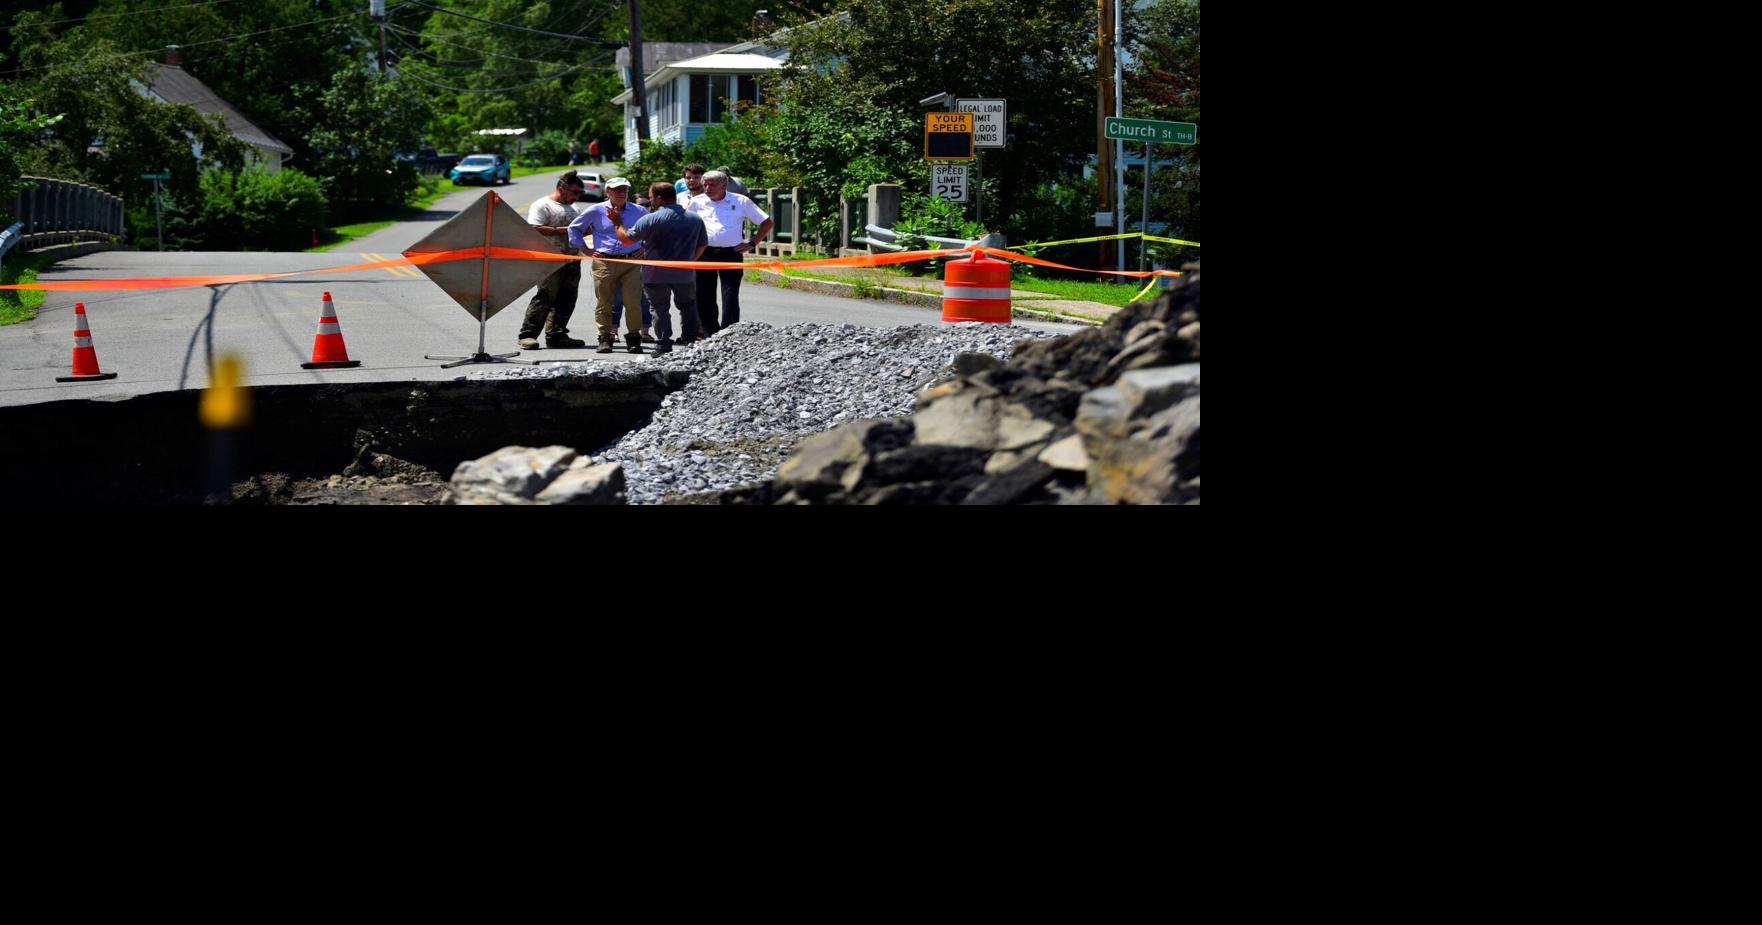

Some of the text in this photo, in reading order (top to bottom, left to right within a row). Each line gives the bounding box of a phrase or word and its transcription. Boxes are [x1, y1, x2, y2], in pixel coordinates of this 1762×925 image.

[935, 115, 965, 123] YOUR
[1109, 122, 1155, 137] Church
[1162, 129, 1171, 139] St
[936, 167, 963, 175] SPEED
[937, 176, 961, 184] LIMIT
[937, 185, 962, 199] 25
